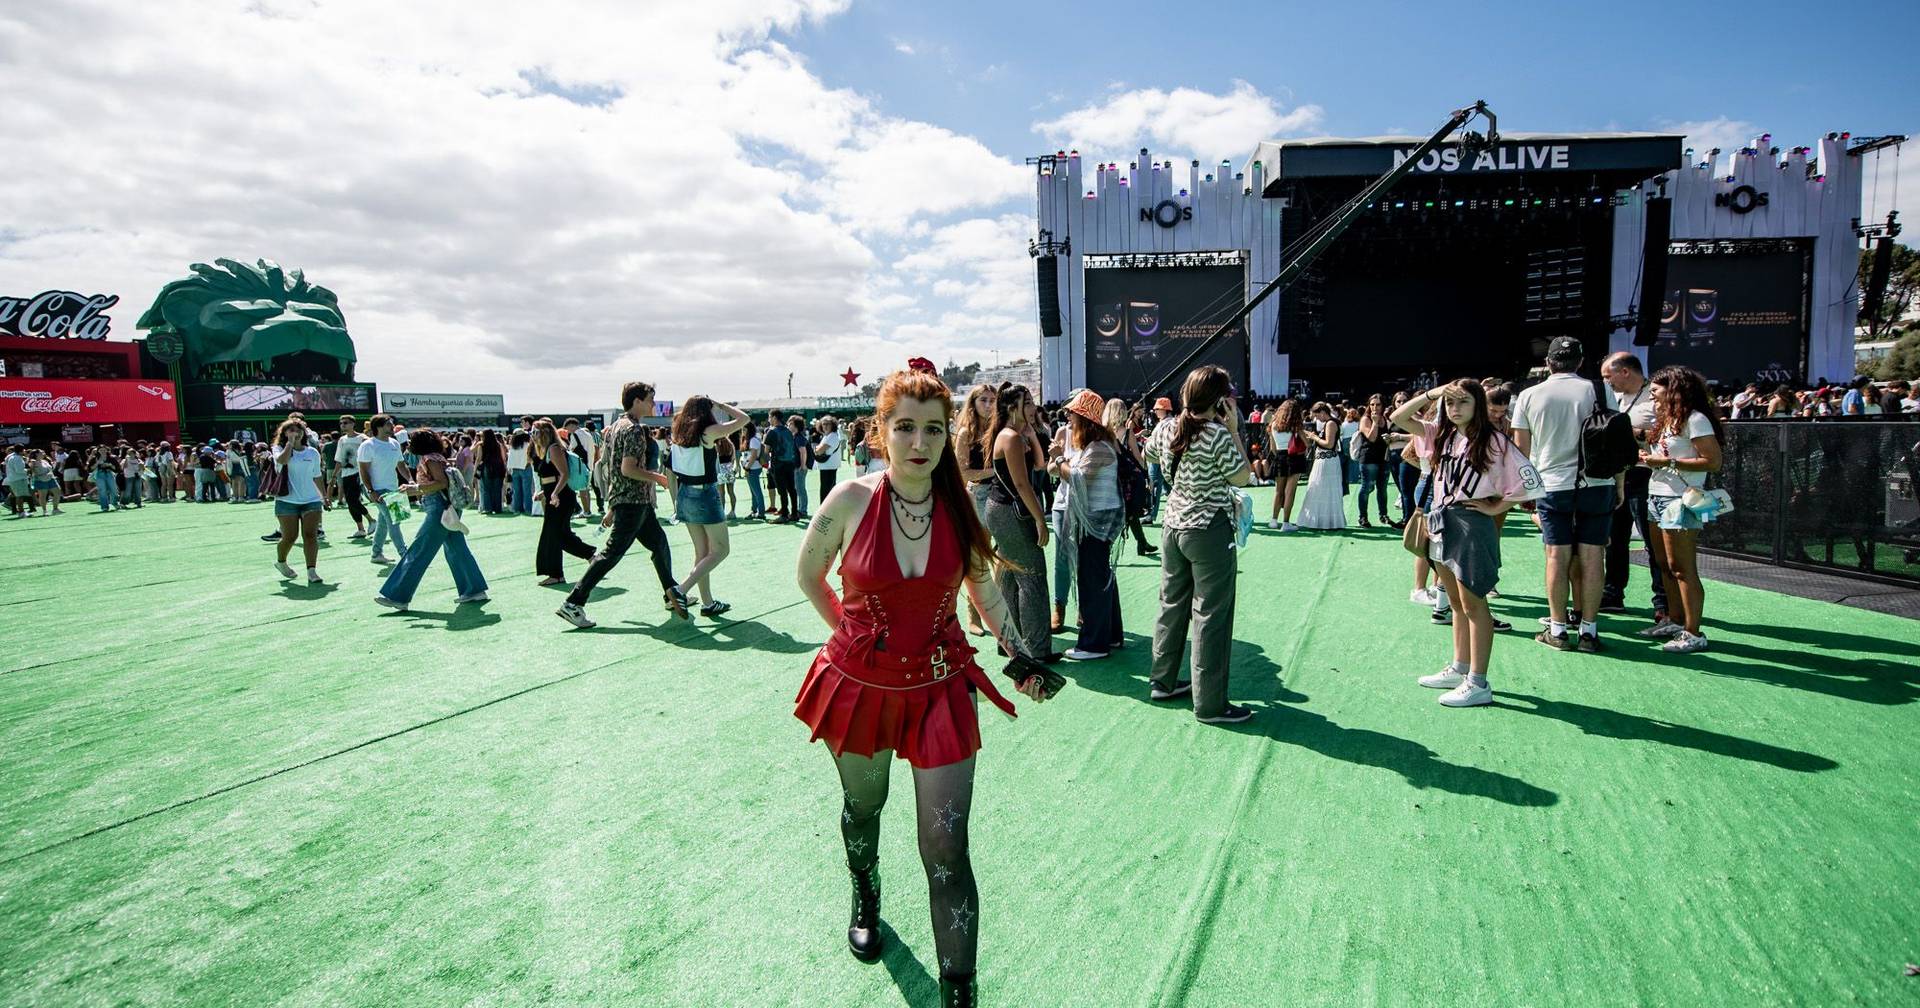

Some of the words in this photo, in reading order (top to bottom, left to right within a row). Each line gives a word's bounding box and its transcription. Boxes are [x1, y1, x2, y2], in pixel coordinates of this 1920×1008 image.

[1393, 148, 1459, 172] NOS
[1472, 146, 1568, 170] ALIVE
[1715, 185, 1769, 214] NOS
[1141, 200, 1192, 228] NOS
[409, 397, 463, 408] Hamburgueria
